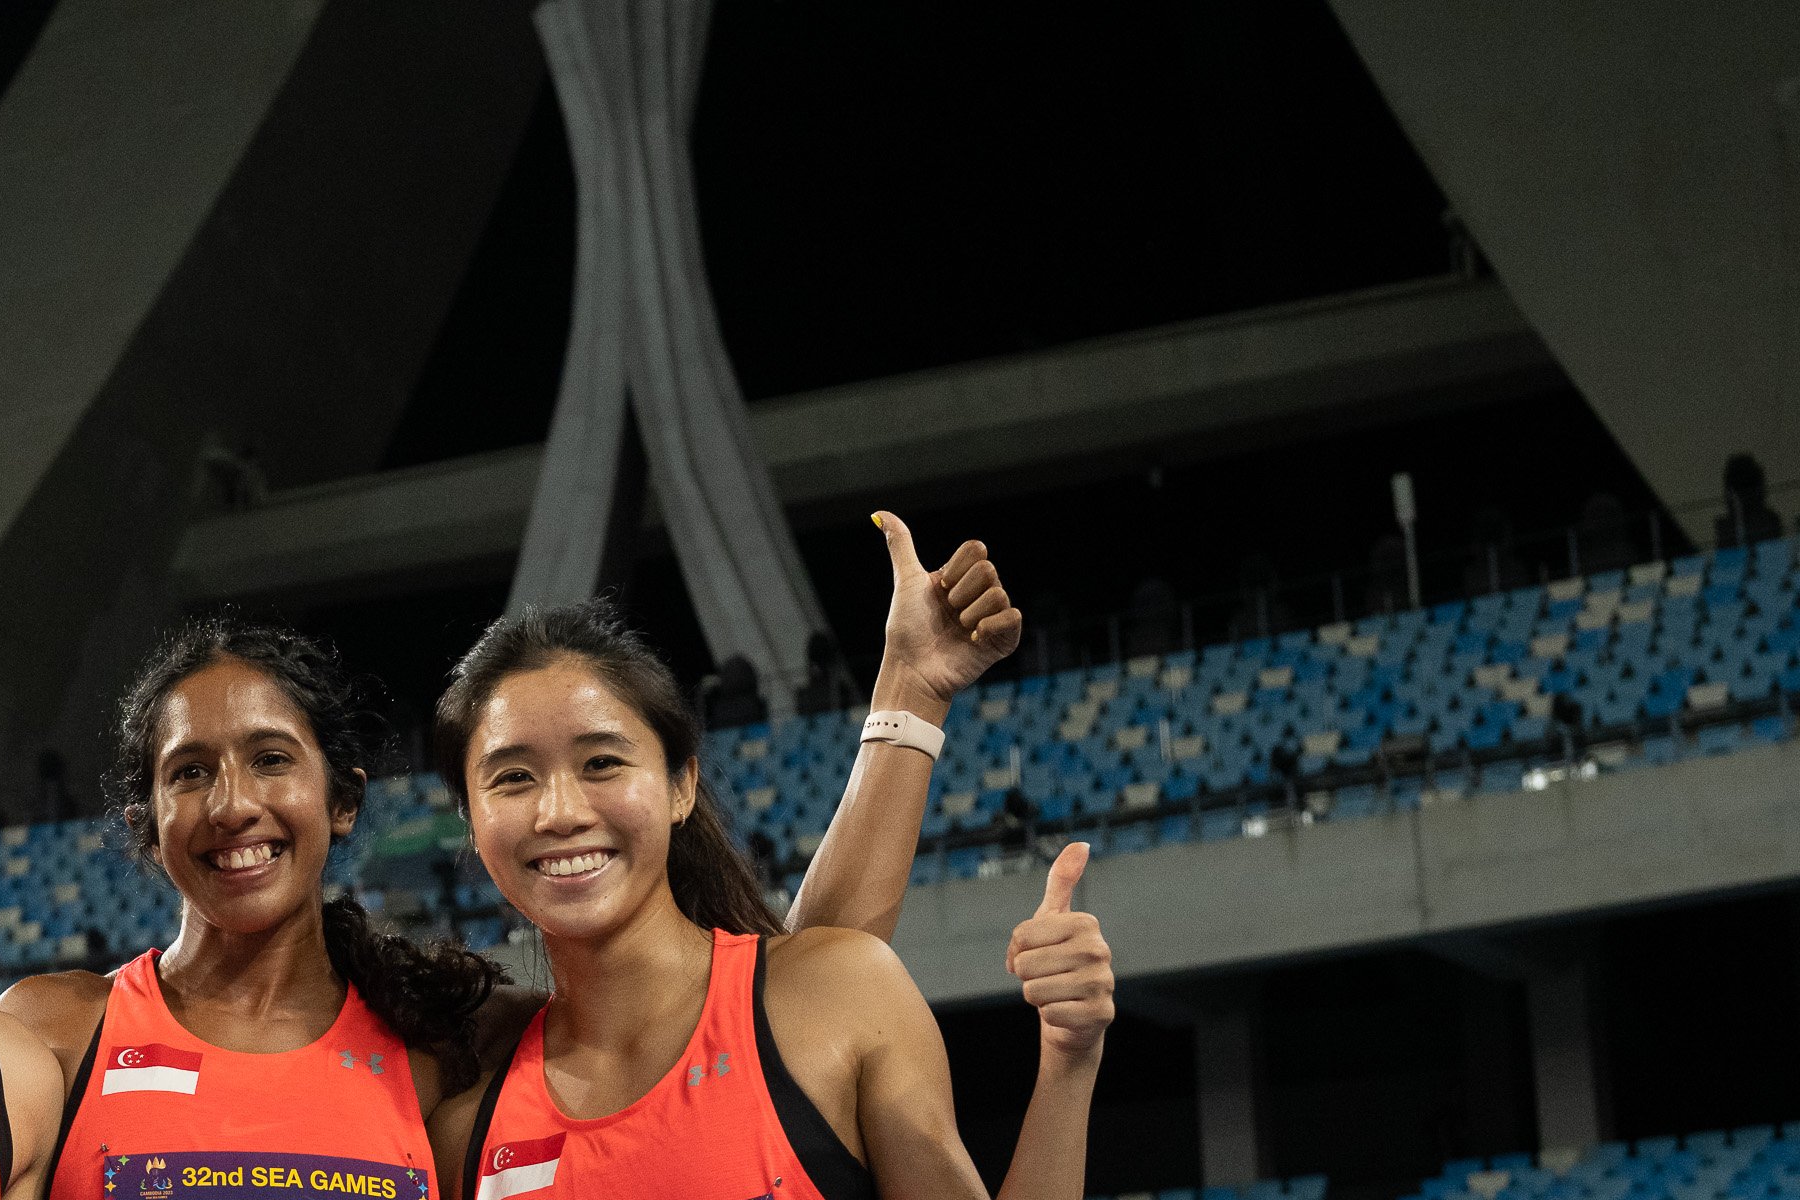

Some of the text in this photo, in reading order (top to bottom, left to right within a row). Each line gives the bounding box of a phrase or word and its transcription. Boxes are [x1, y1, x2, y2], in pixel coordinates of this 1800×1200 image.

[183, 1166, 397, 1199] 32nd SEA GAMES
